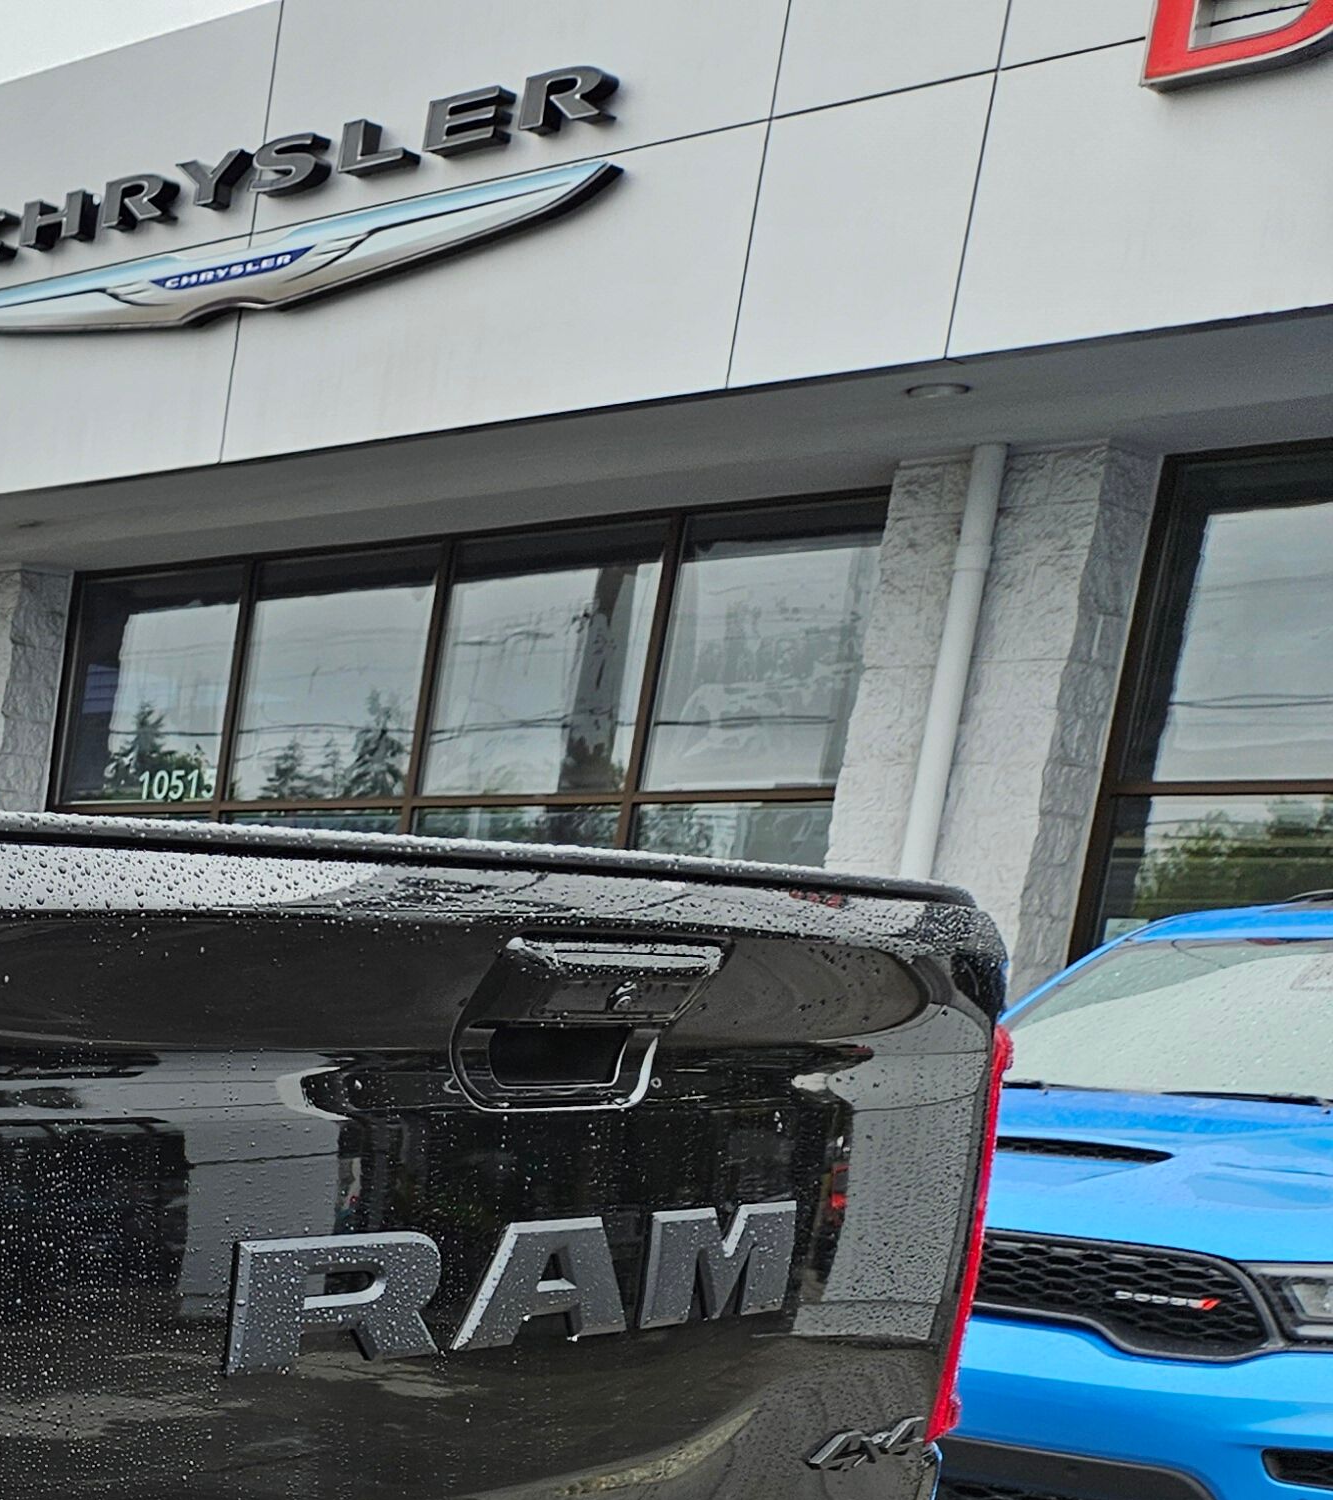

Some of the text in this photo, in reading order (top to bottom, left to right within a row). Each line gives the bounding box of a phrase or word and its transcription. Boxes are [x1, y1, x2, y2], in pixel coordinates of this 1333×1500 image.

[164, 253, 293, 290] CHRYSLER
[138, 768, 218, 801] 10515
[225, 1200, 798, 1377] RAM
